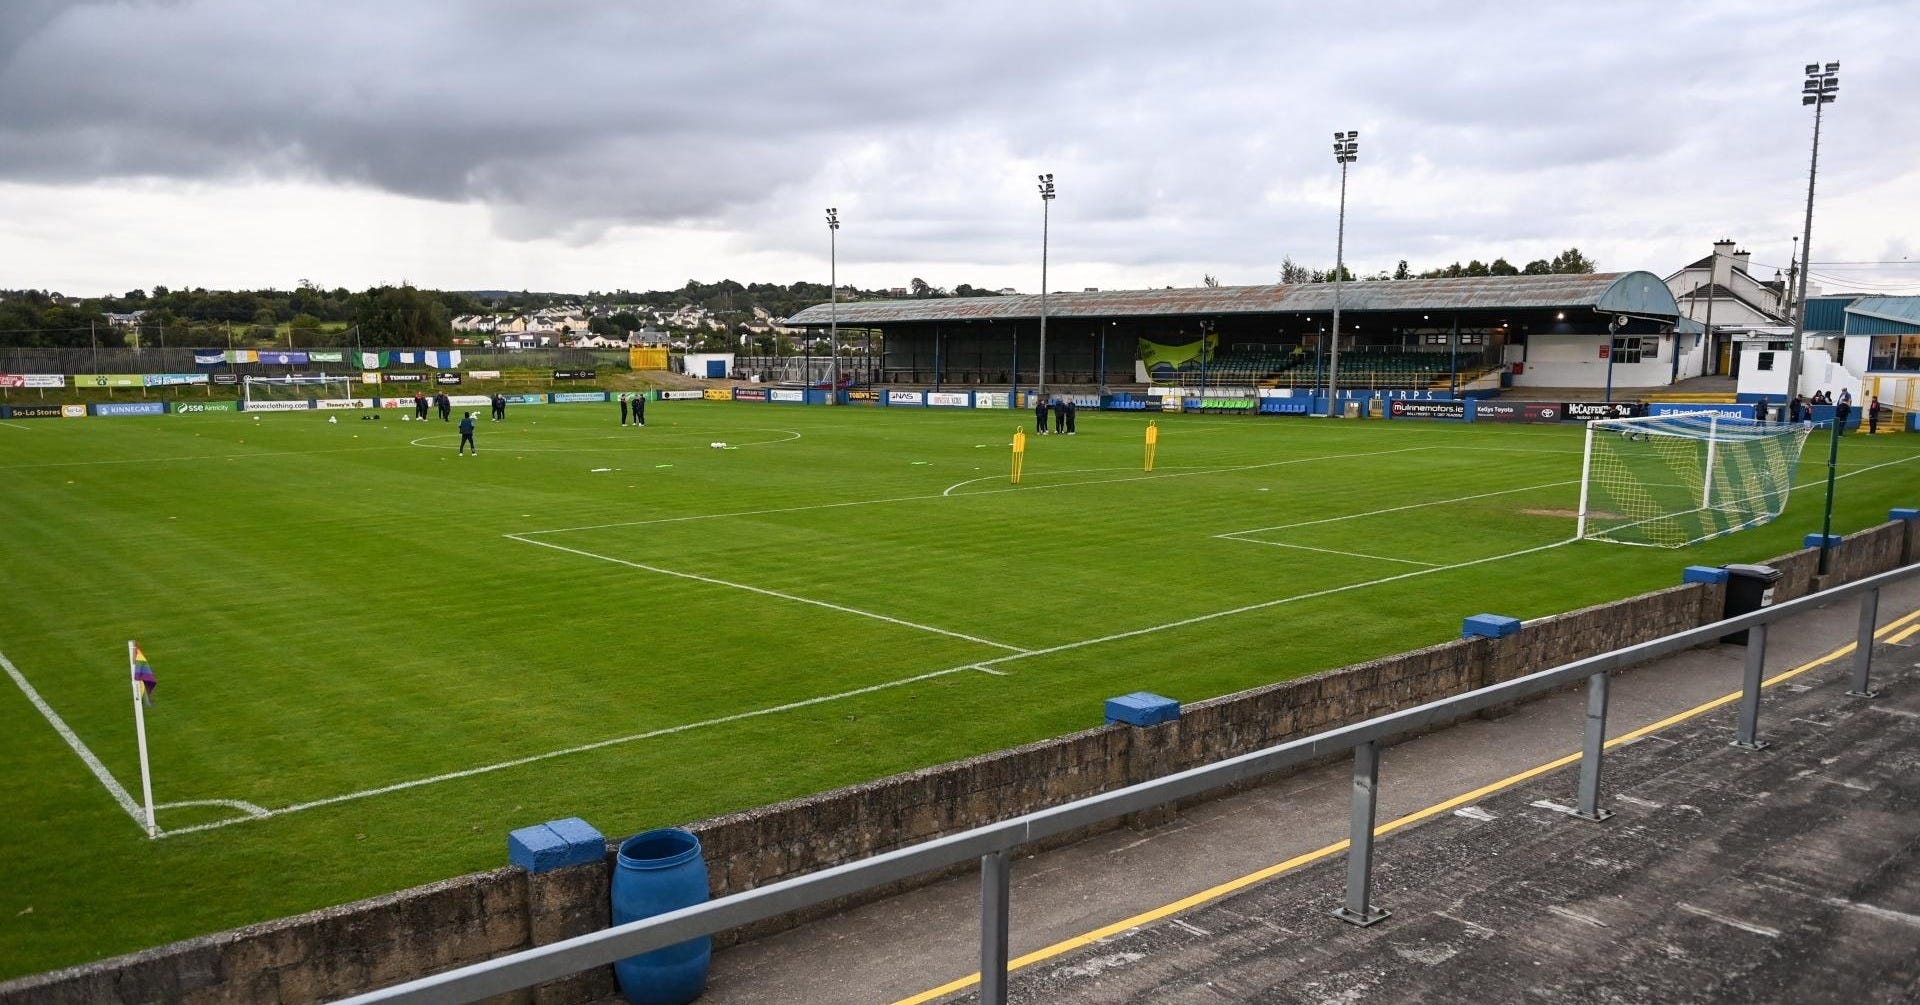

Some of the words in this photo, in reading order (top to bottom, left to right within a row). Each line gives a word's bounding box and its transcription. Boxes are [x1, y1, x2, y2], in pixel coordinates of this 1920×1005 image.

[188, 404, 204, 412] sse
[204, 404, 229, 412] Airtricity
[1477, 406, 1494, 414] Kellys
[1494, 406, 1514, 414] Toyota
